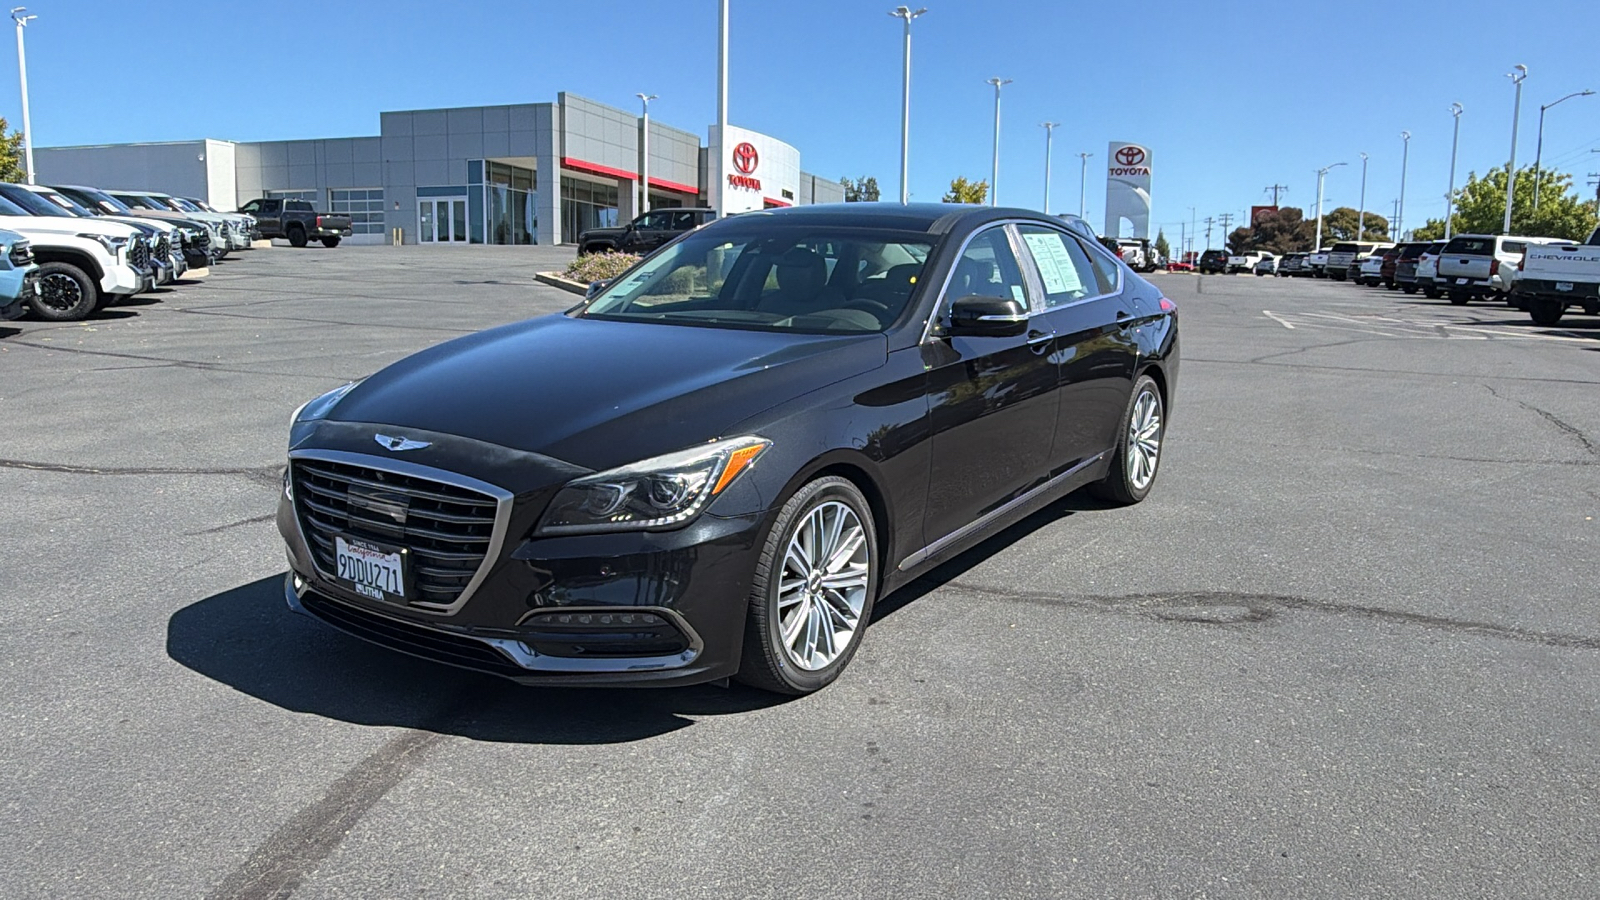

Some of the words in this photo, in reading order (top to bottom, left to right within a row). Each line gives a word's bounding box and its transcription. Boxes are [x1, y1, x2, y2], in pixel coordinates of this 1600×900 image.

[1109, 168, 1150, 176] TOYOTA
[727, 173, 762, 191] TOYOTA
[1529, 254, 1600, 262] CHEVROLE
[339, 553, 401, 594] 9DDU271
